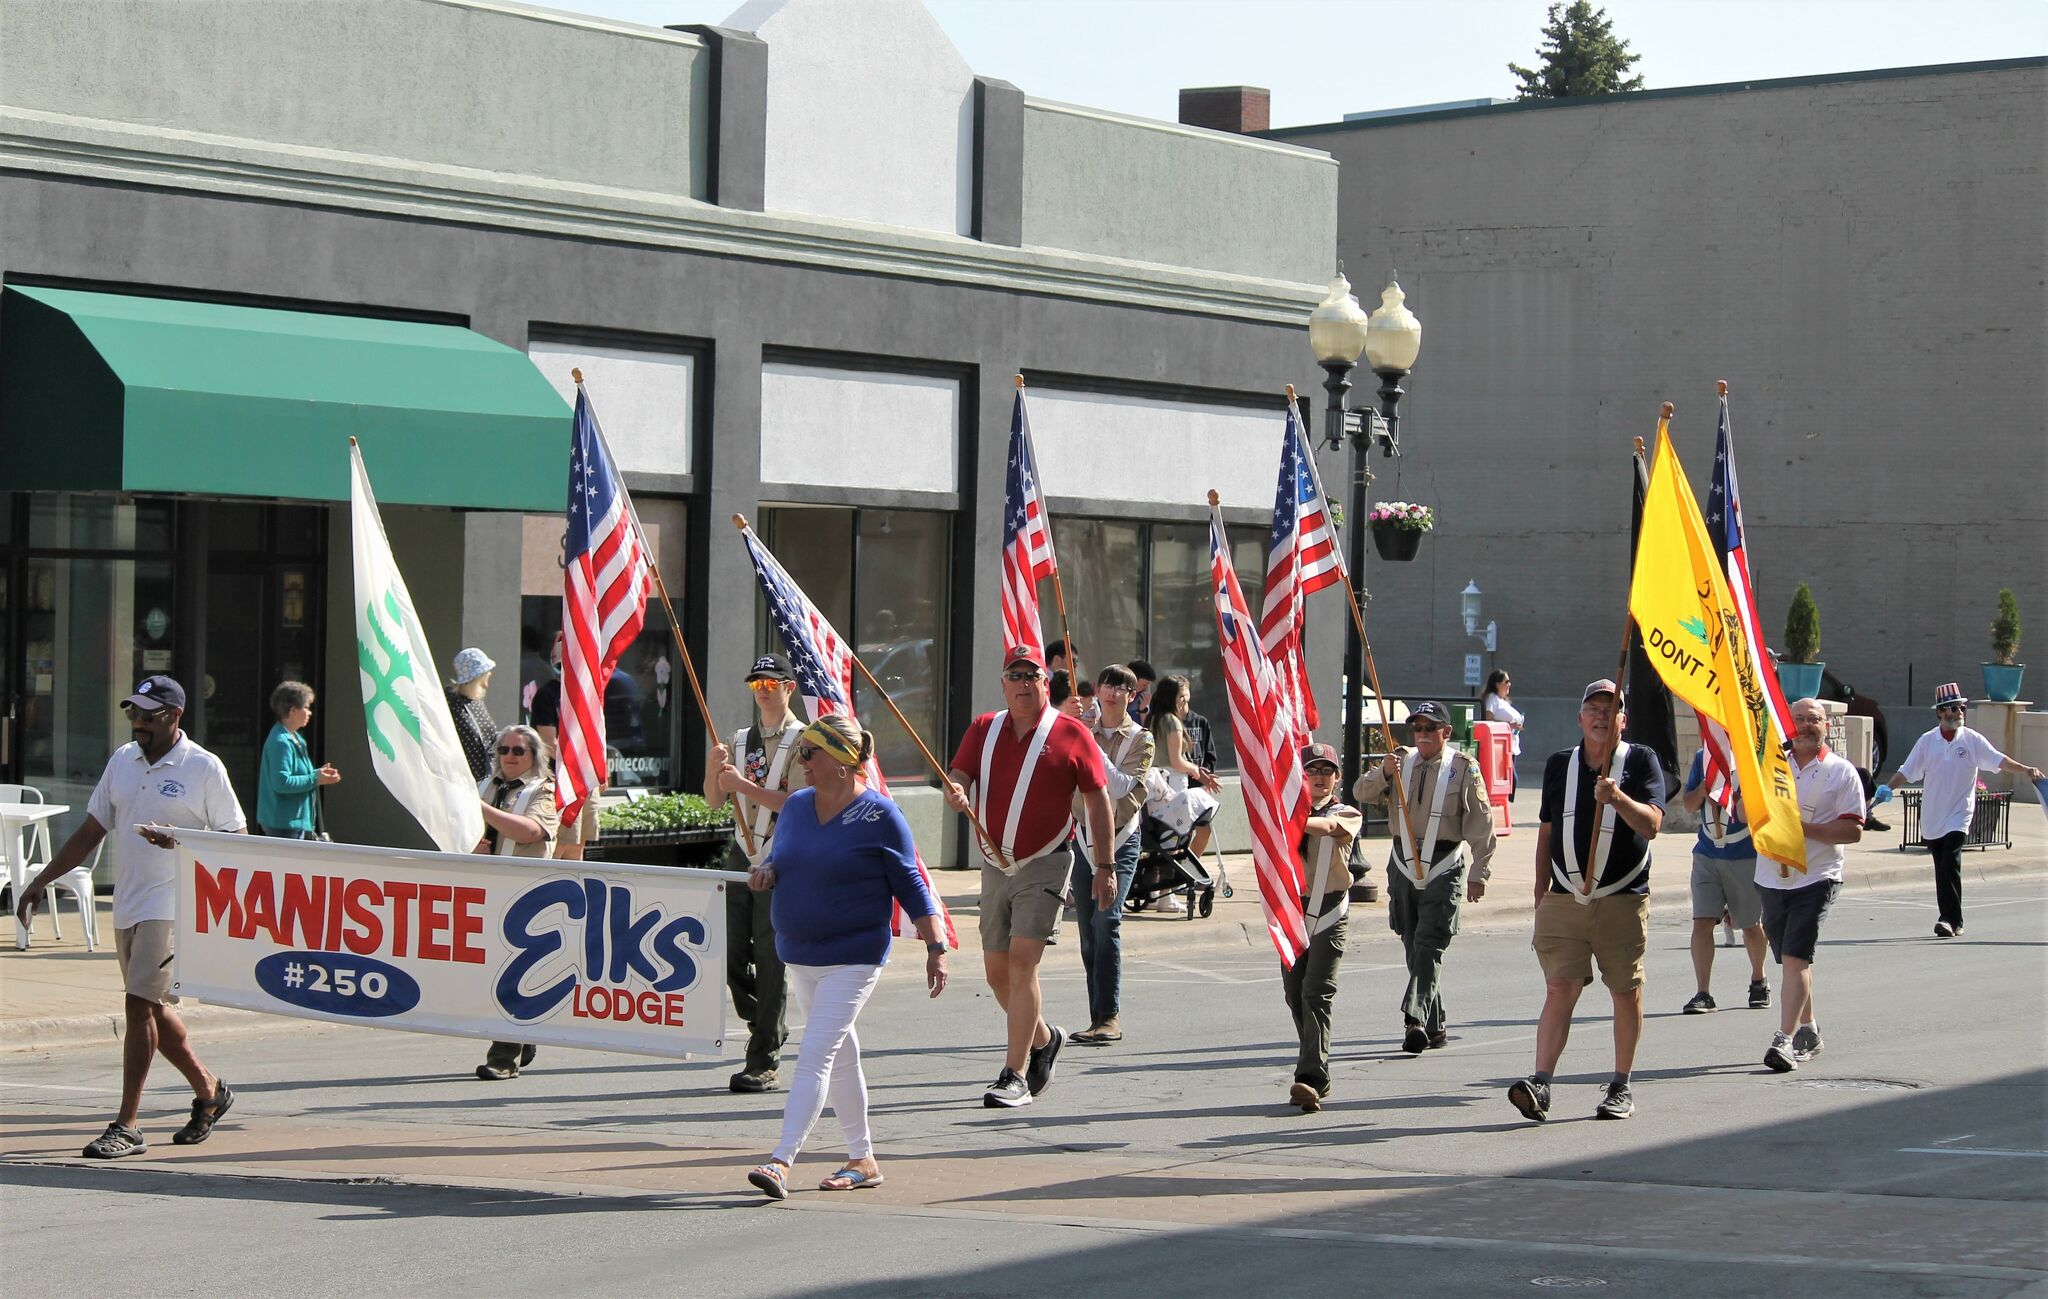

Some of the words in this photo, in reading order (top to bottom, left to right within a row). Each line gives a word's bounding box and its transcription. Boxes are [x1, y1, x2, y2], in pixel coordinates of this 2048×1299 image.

[1649, 627, 1704, 676] DONT
[607, 754, 672, 775] piceco.com
[842, 801, 884, 825] Elks
[195, 860, 486, 964] MANISTEE
[498, 878, 705, 1020] Elks
[283, 961, 388, 999] #250
[572, 985, 685, 1028] LODGE
